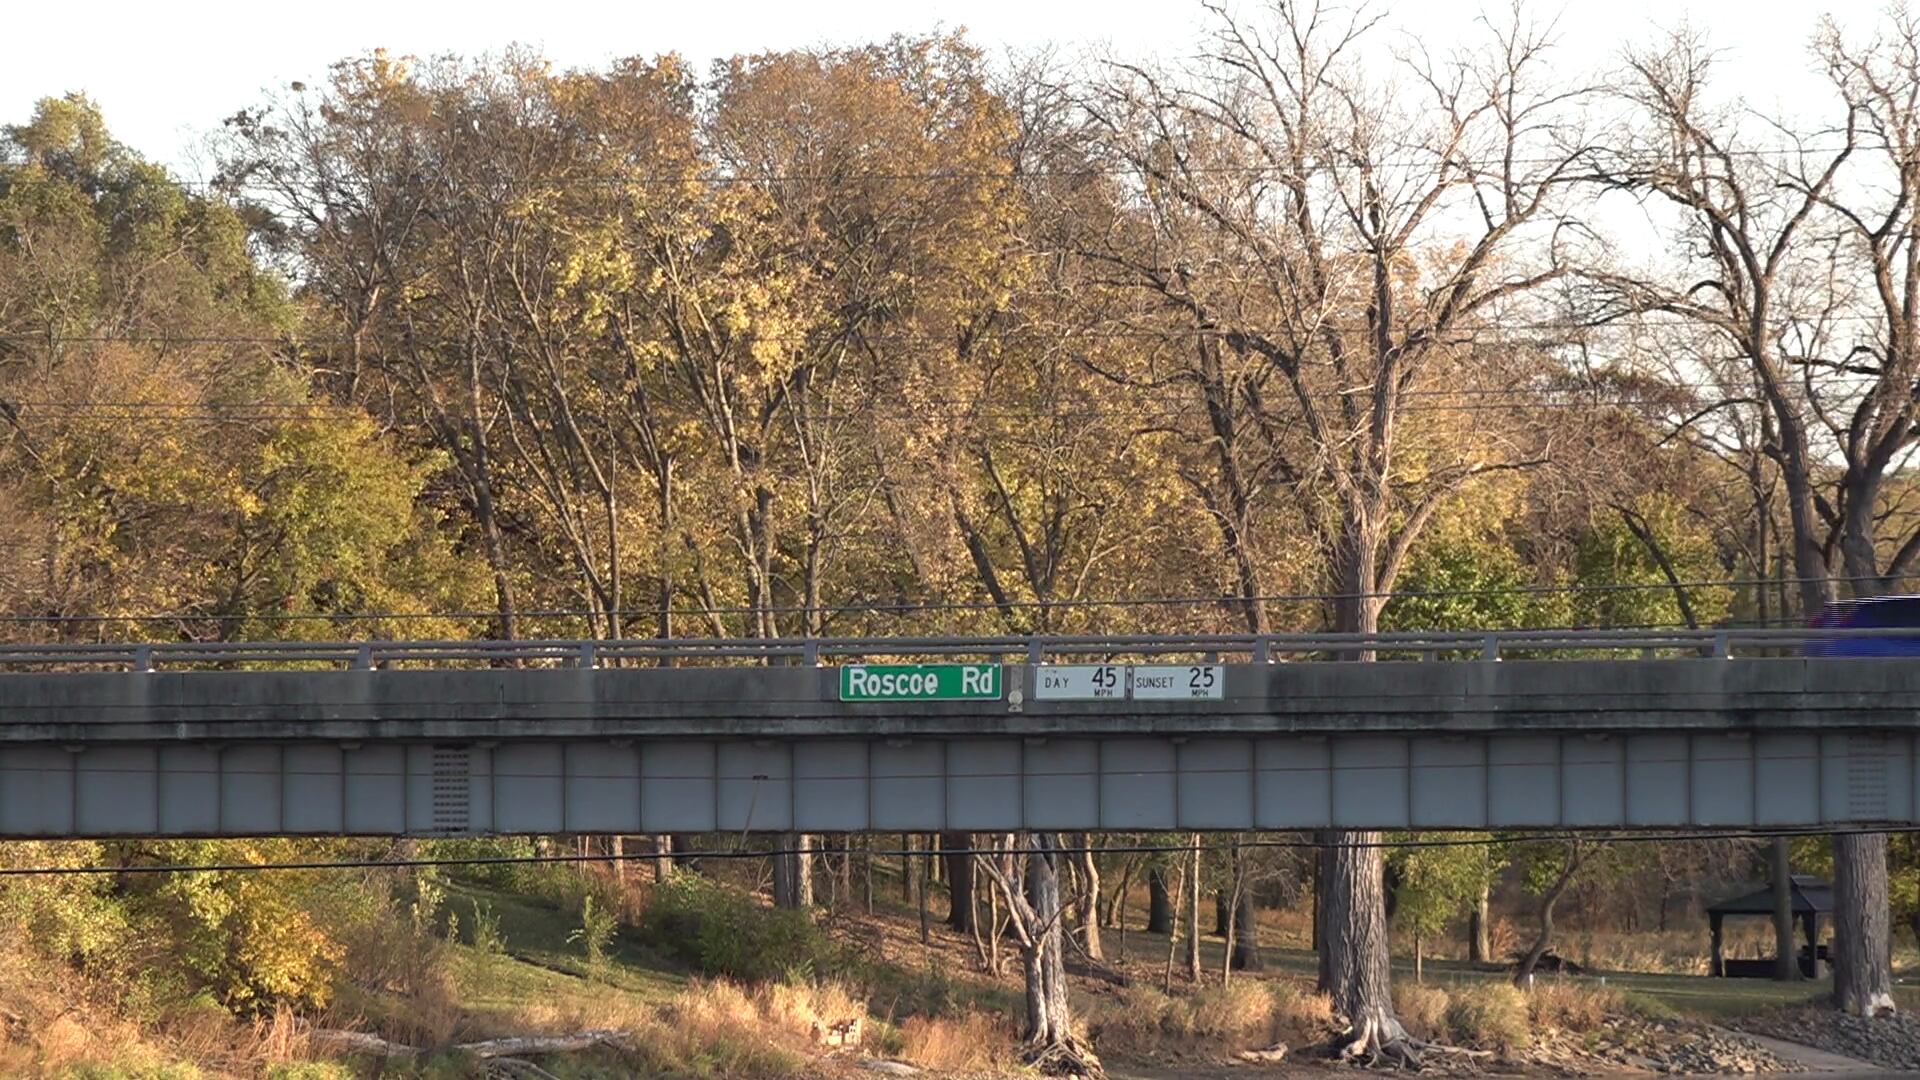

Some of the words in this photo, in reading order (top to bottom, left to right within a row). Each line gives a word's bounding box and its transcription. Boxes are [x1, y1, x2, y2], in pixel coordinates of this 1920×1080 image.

[850, 668, 938, 696] Roscoe
[962, 666, 993, 694] Rd
[1045, 677, 1070, 689] DAY
[1092, 667, 1117, 688] 45
[1136, 677, 1176, 689] SUNSET
[1189, 667, 1214, 688] 25
[1094, 689, 1113, 697] MPH
[1191, 689, 1209, 697] MPH
